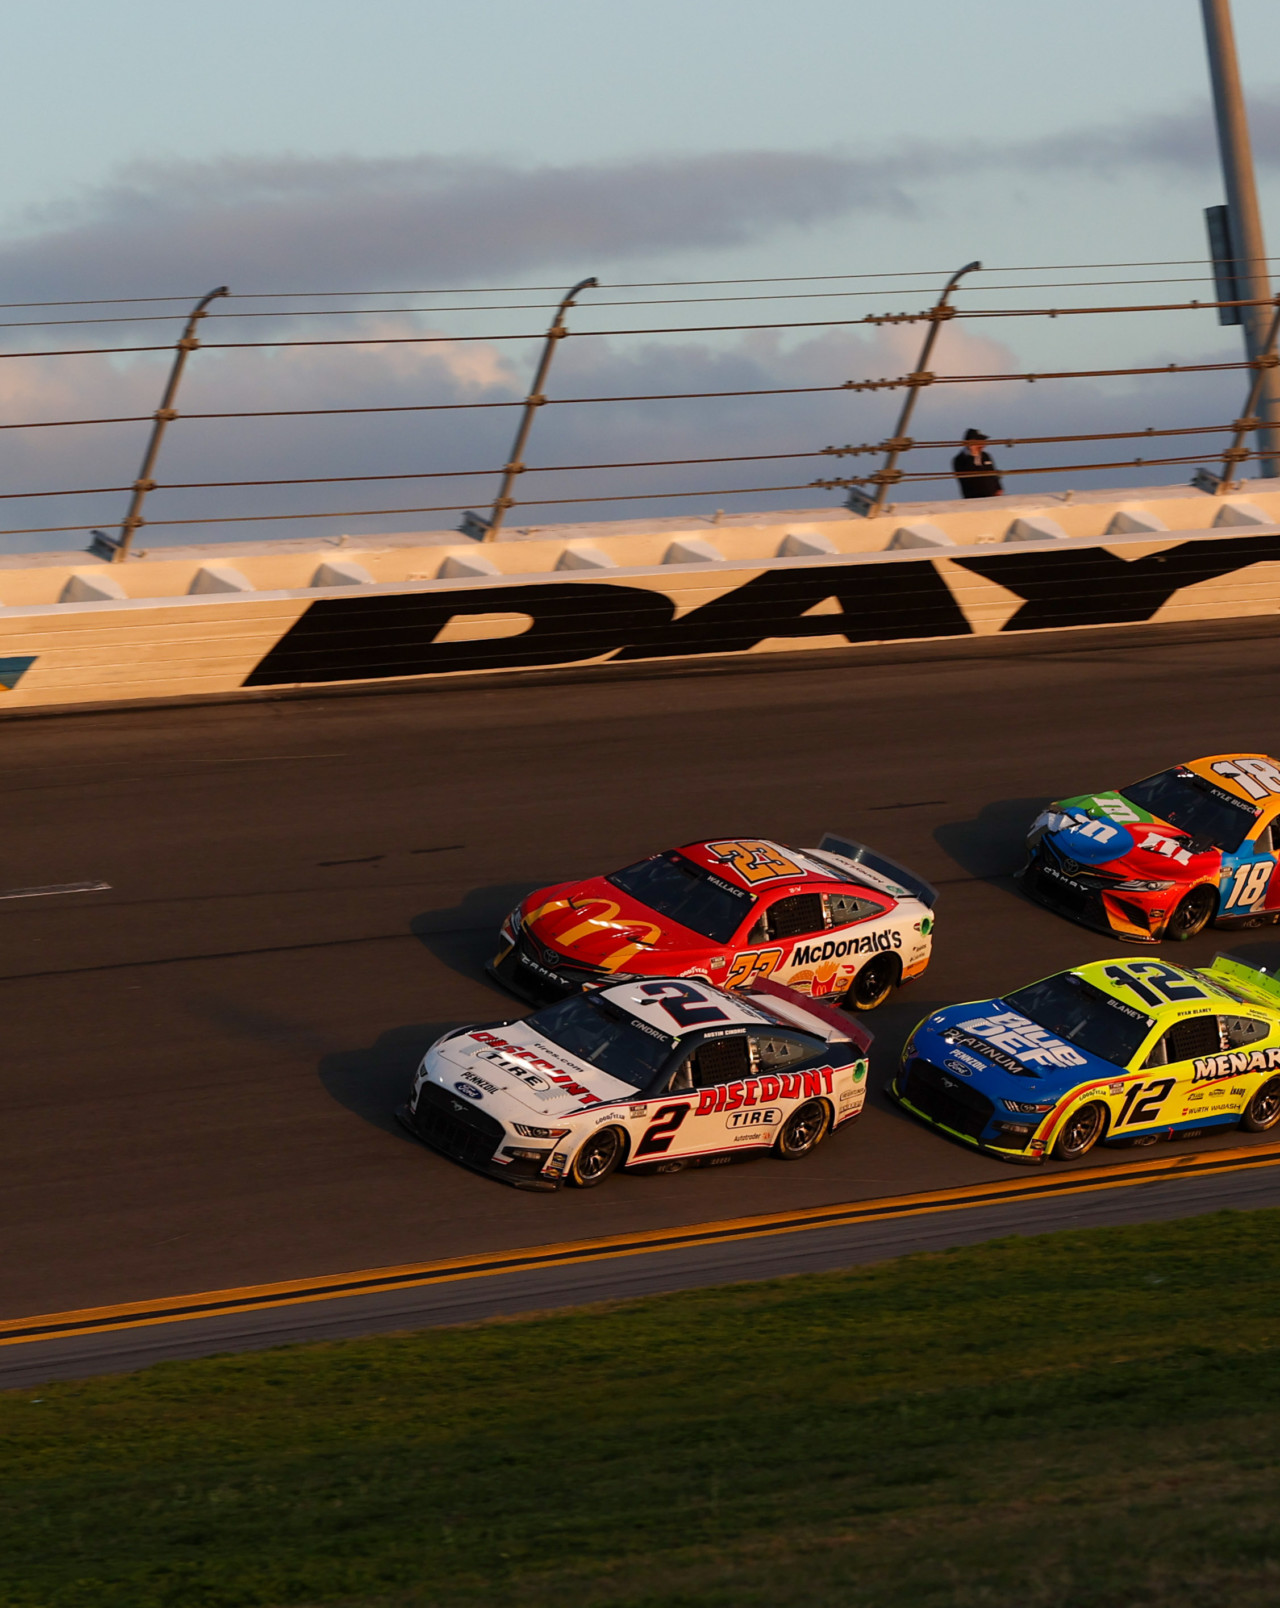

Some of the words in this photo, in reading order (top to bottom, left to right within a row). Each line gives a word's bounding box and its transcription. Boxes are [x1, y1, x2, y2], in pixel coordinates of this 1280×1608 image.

[1210, 789, 1231, 803] KYLE
[705, 839, 808, 887] 23
[707, 875, 744, 898] WALLACE
[1224, 860, 1277, 910] 18
[791, 929, 903, 967] McDonald's
[677, 966, 708, 978] OODYEAR
[1104, 962, 1208, 1009] 12
[640, 981, 731, 1028] 2
[1107, 998, 1144, 1021] BLANEY
[631, 1019, 667, 1043] CINDRIC
[704, 1031, 724, 1039] AUSTIN
[724, 1028, 747, 1036] CINDRIC
[957, 1018, 1067, 1068] DEF
[986, 1011, 1088, 1068] BLUE
[534, 1042, 585, 1073] tires.com
[943, 1028, 1024, 1074] PLATINUM
[949, 1049, 988, 1072] PENNZOIL
[460, 1071, 500, 1095] PENNZOIL
[468, 1032, 603, 1104] DISCOUNT
[487, 1052, 544, 1087] TIRE
[946, 1060, 971, 1076] Ford
[456, 1083, 482, 1098] Ford
[694, 1065, 836, 1116] DISCOUNT
[1113, 1077, 1177, 1129] 12
[633, 1101, 692, 1159] 2
[732, 1109, 775, 1127] TIRE
[733, 1131, 762, 1143] Autotrader
